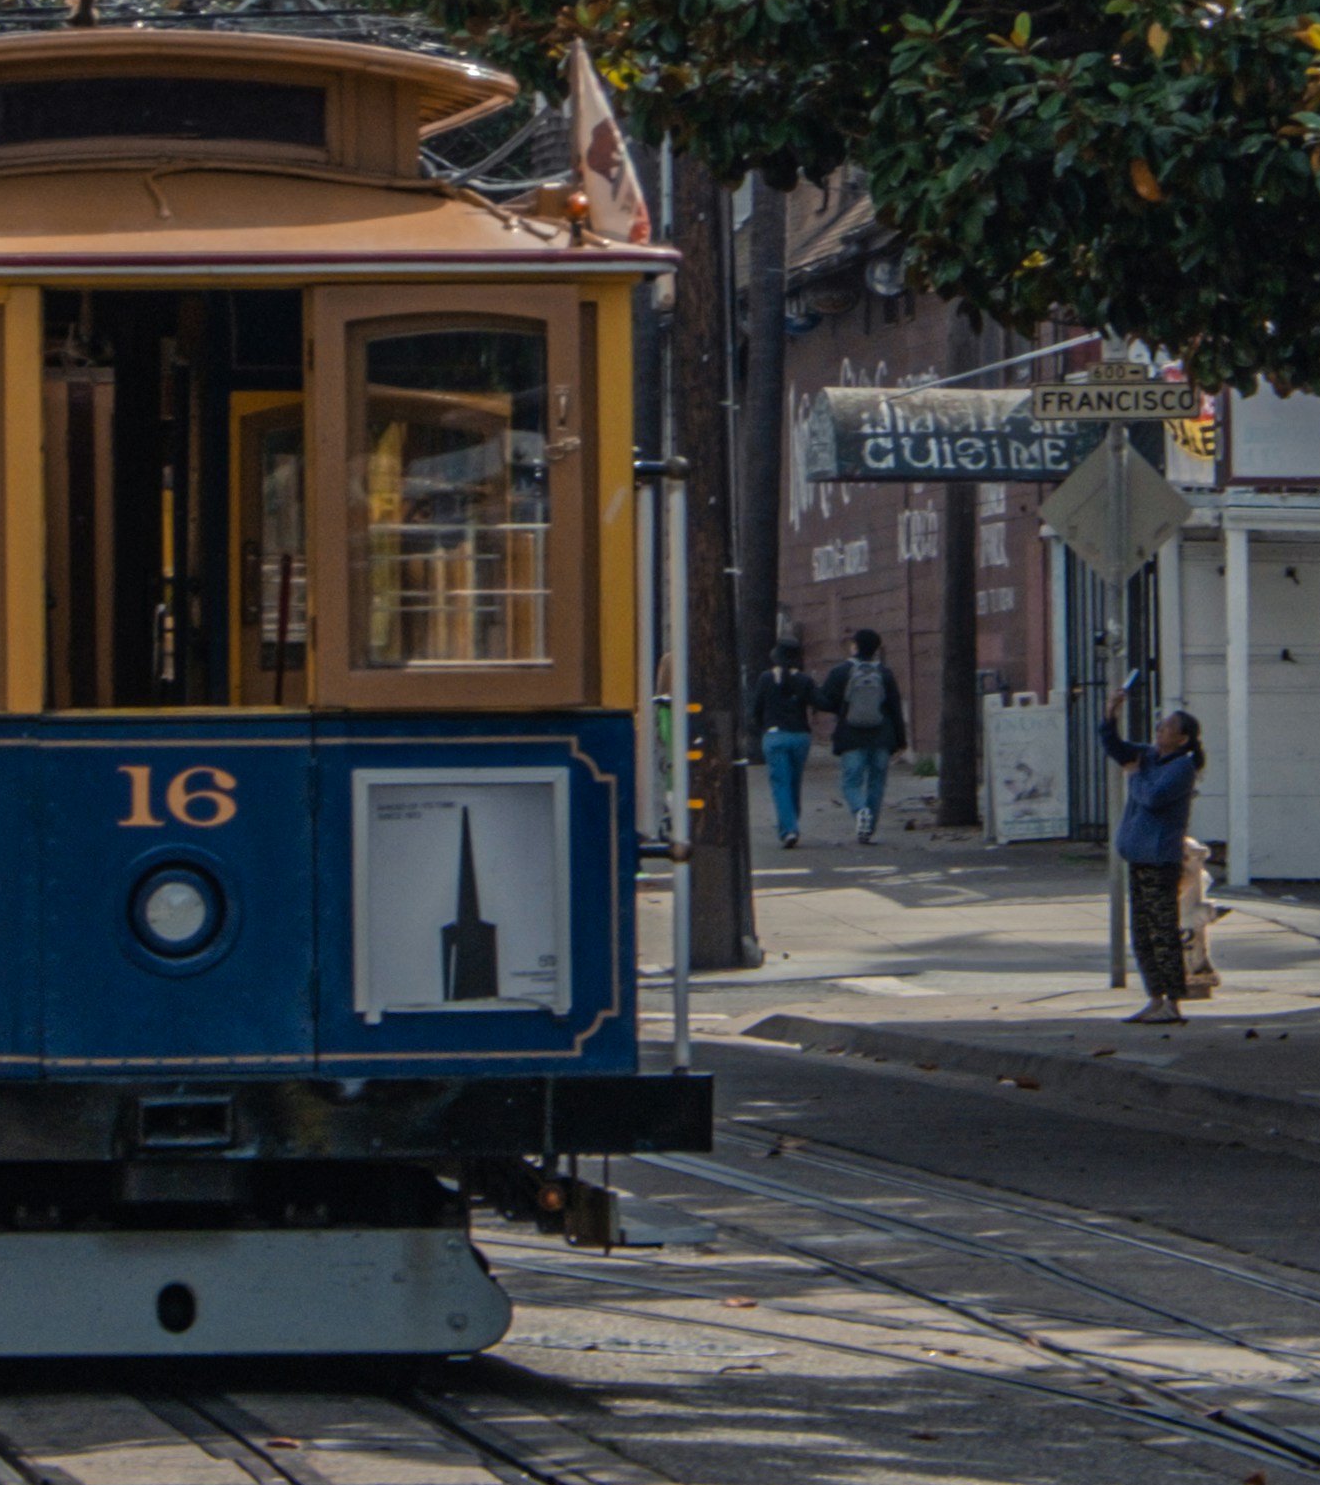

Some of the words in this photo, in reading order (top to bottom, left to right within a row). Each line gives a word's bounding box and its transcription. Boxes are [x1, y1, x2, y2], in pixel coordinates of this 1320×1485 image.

[1092, 365, 1126, 379] 600
[1041, 390, 1194, 412] FRANCISCO
[117, 764, 238, 828] 16
